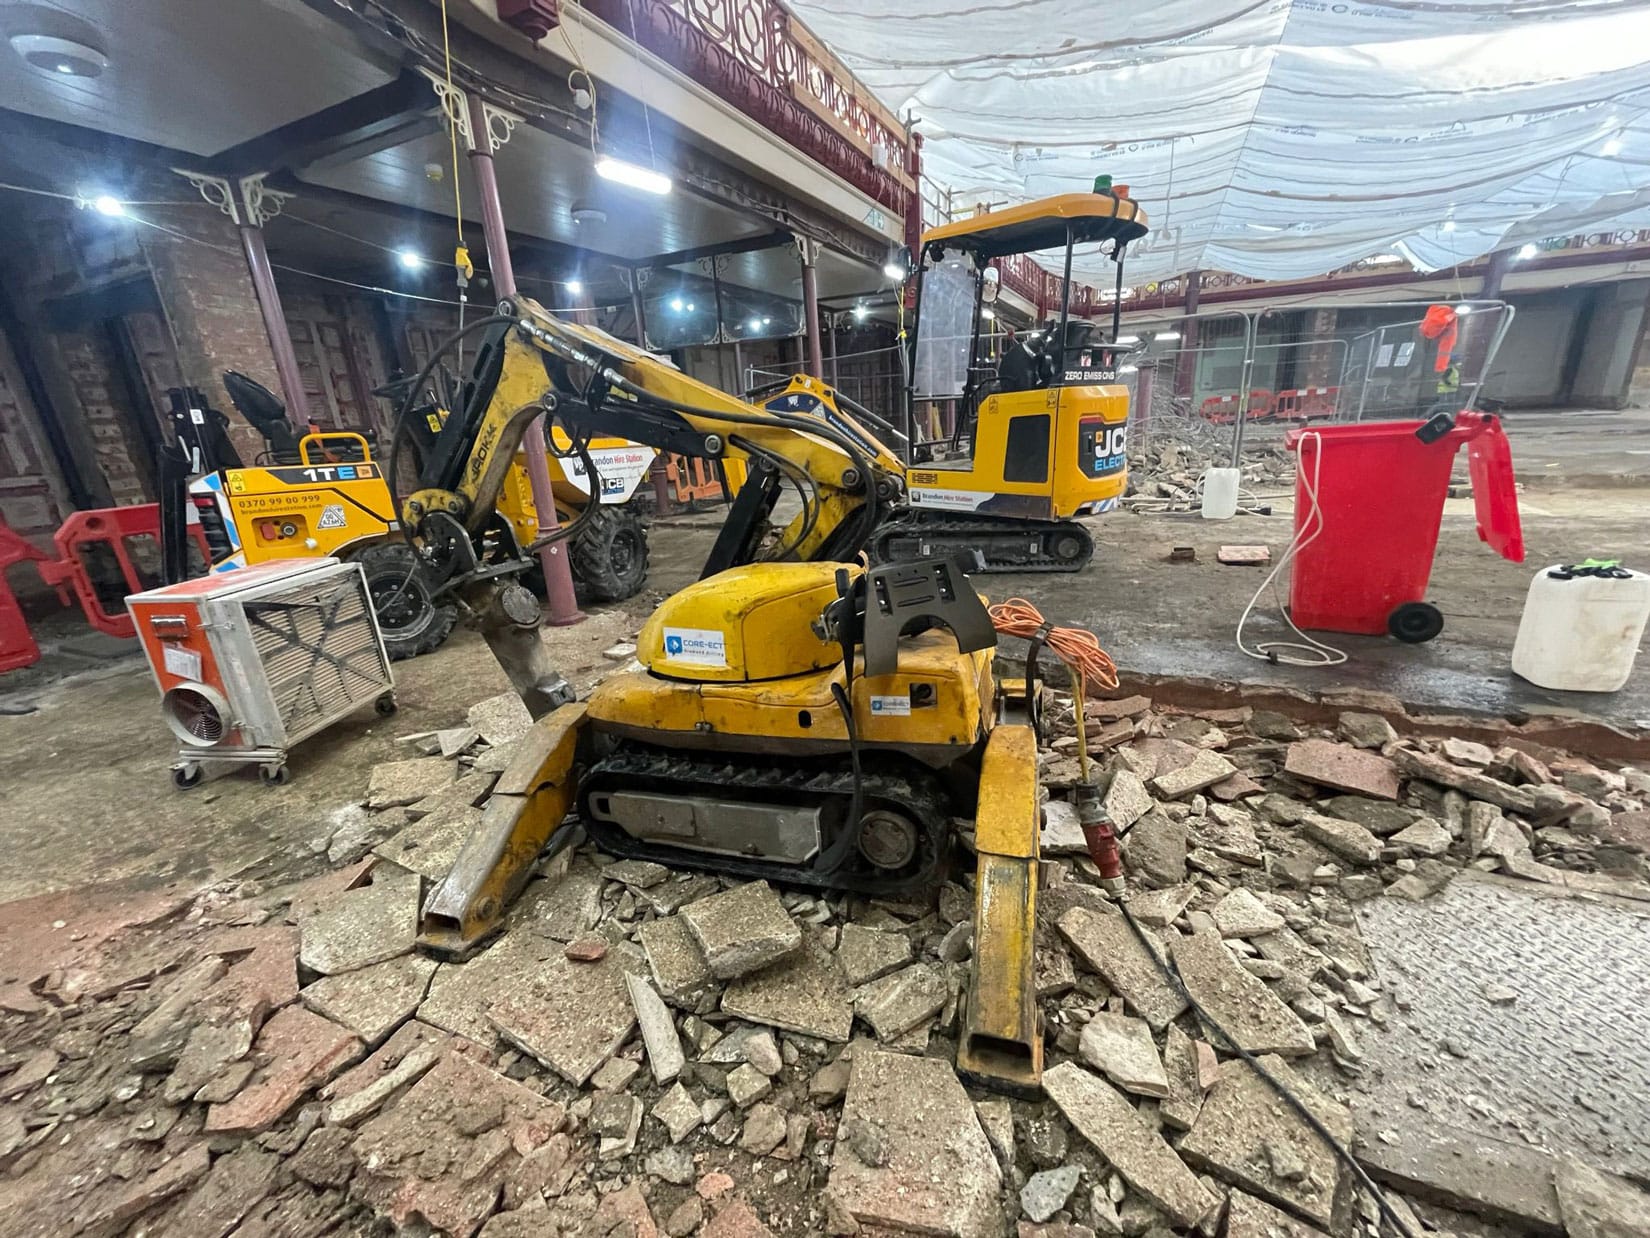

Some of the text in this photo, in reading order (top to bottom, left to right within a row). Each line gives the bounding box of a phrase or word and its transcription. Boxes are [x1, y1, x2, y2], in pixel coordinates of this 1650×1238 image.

[1064, 371, 1083, 380] ZERO
[1095, 426, 1128, 458] JC
[594, 454, 644, 466] andon Hire Station
[303, 466, 356, 482] 1TE
[238, 494, 321, 509] 0370 99 00 999
[683, 639, 723, 649] CORE-ECT
